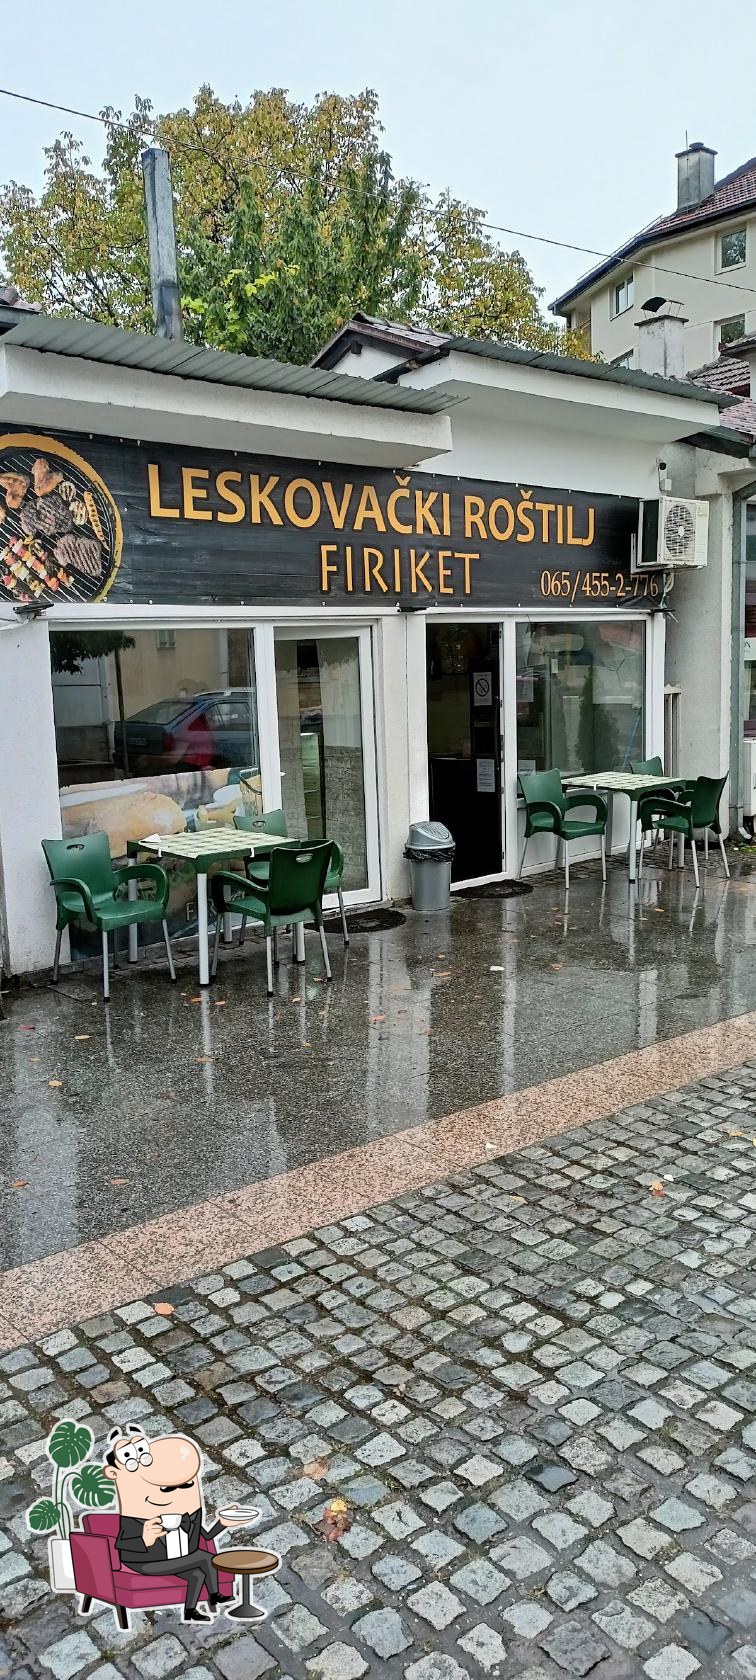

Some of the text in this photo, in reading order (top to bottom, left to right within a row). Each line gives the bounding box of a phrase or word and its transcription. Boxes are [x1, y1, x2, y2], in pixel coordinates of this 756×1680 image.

[147, 463, 595, 546] LESKOVAČKI ROŠTILJ
[320, 544, 480, 594] FIRIKET
[540, 570, 659, 603] 065/455-2-776
